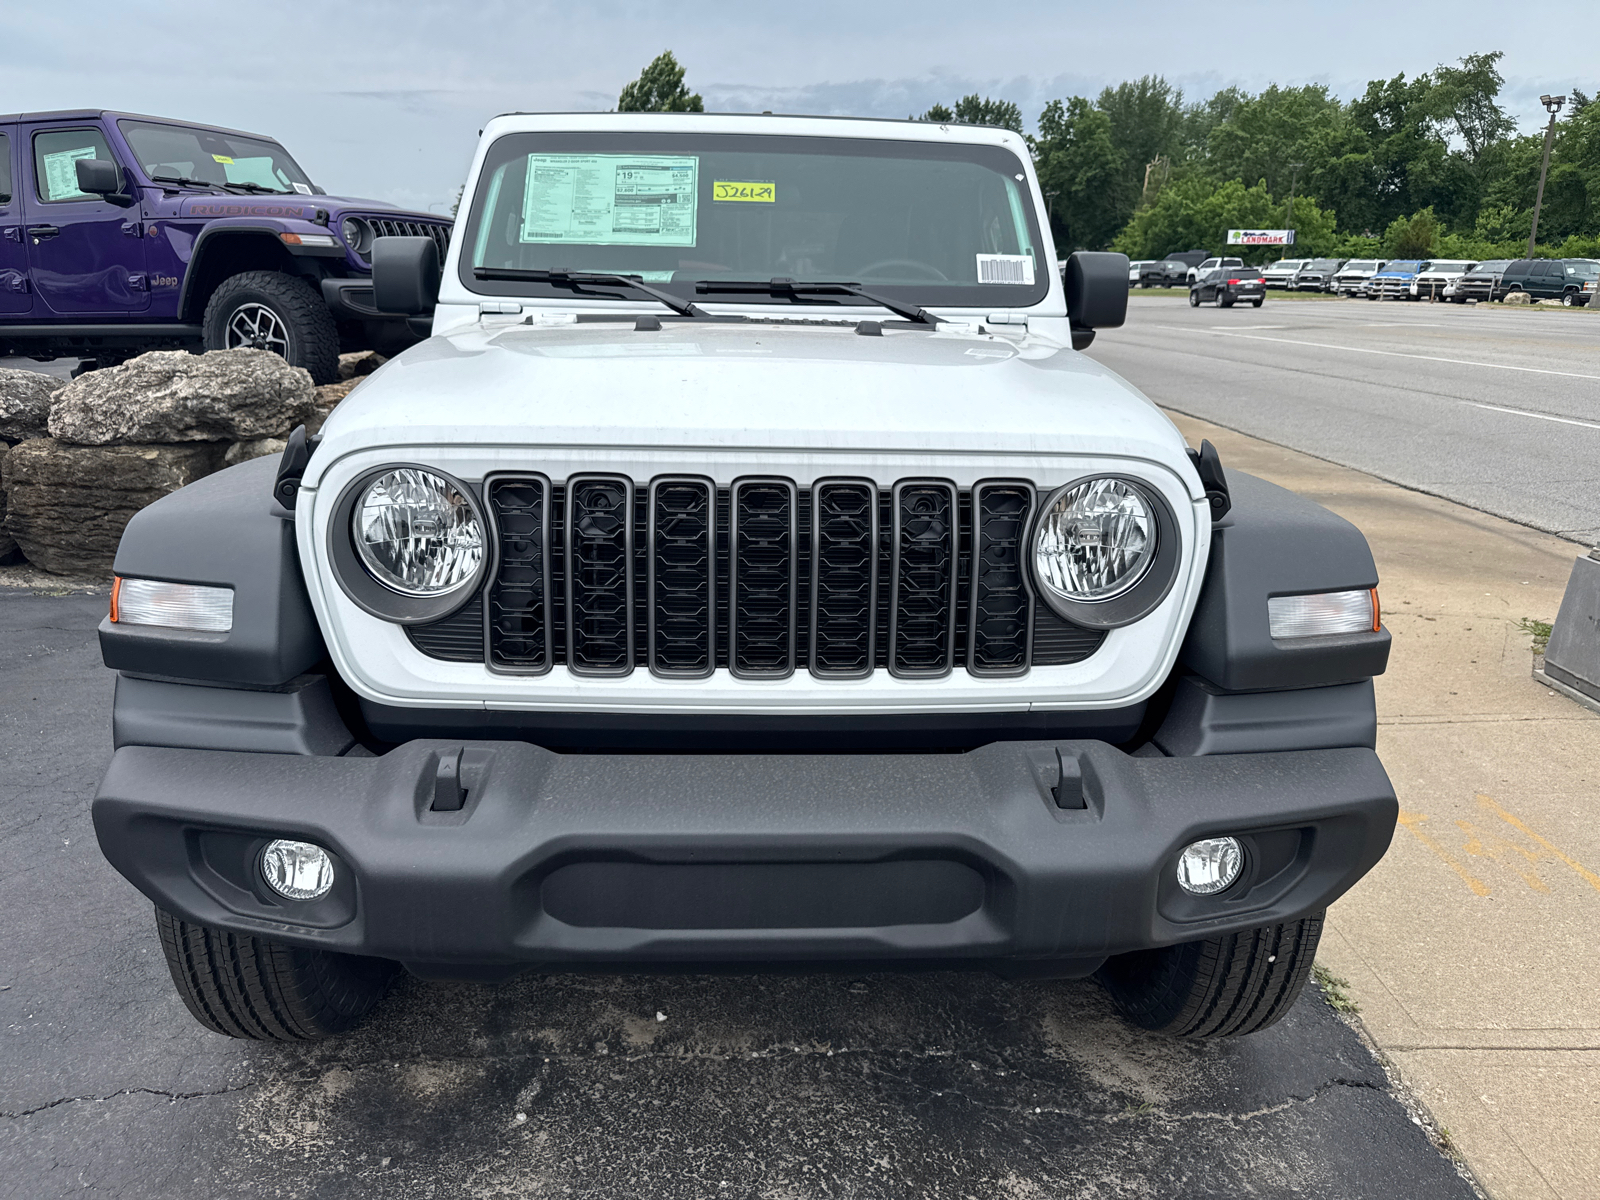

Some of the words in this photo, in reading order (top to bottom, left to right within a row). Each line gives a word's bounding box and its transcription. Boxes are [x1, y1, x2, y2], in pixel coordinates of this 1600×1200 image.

[622, 171, 633, 180] 19
[716, 184, 772, 199] J26129
[189, 204, 304, 217] RUBICON
[1241, 236, 1283, 244] LANDMARK
[152, 274, 178, 287] Jeep
